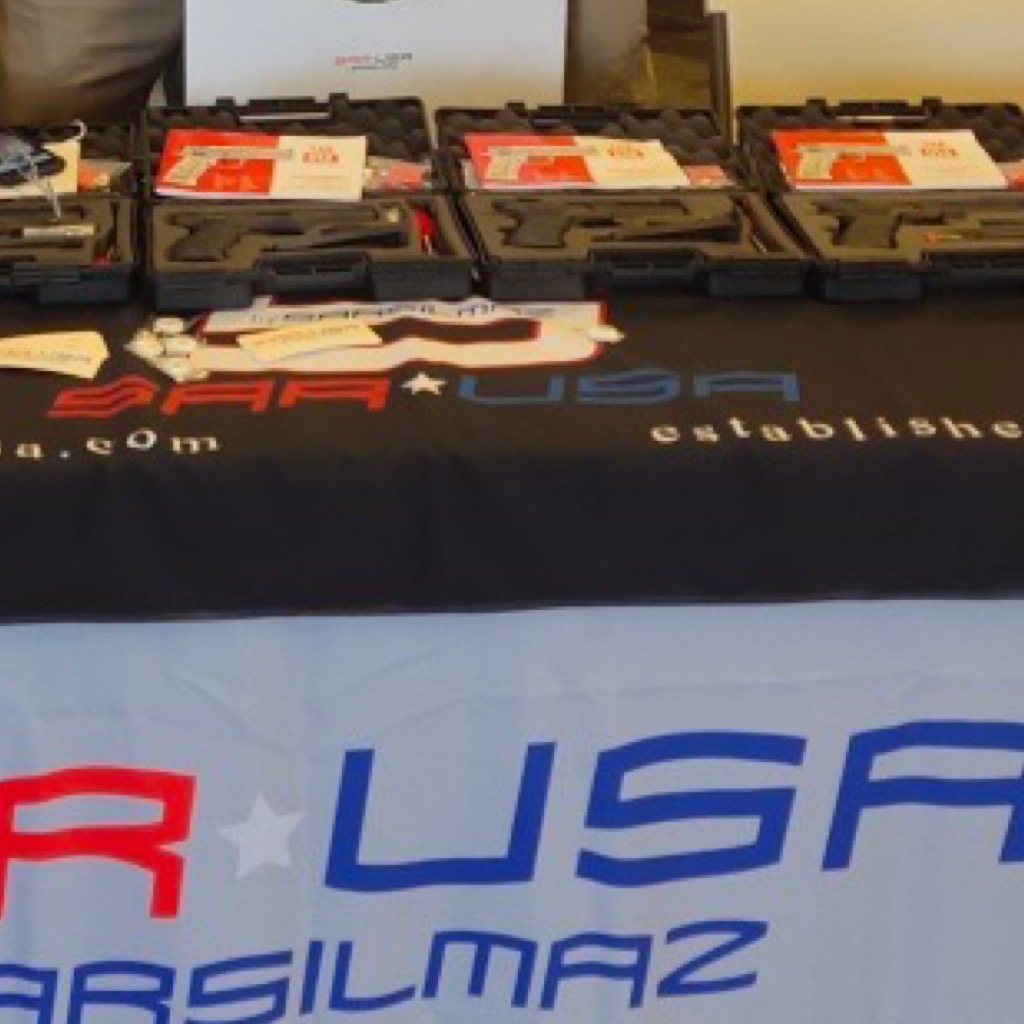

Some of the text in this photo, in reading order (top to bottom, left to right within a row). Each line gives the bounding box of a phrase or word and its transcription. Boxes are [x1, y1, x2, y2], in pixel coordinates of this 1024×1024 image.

[48, 369, 800, 417] SAR USA
[651, 416, 1024, 443] establishe
[325, 721, 1024, 893] USA
